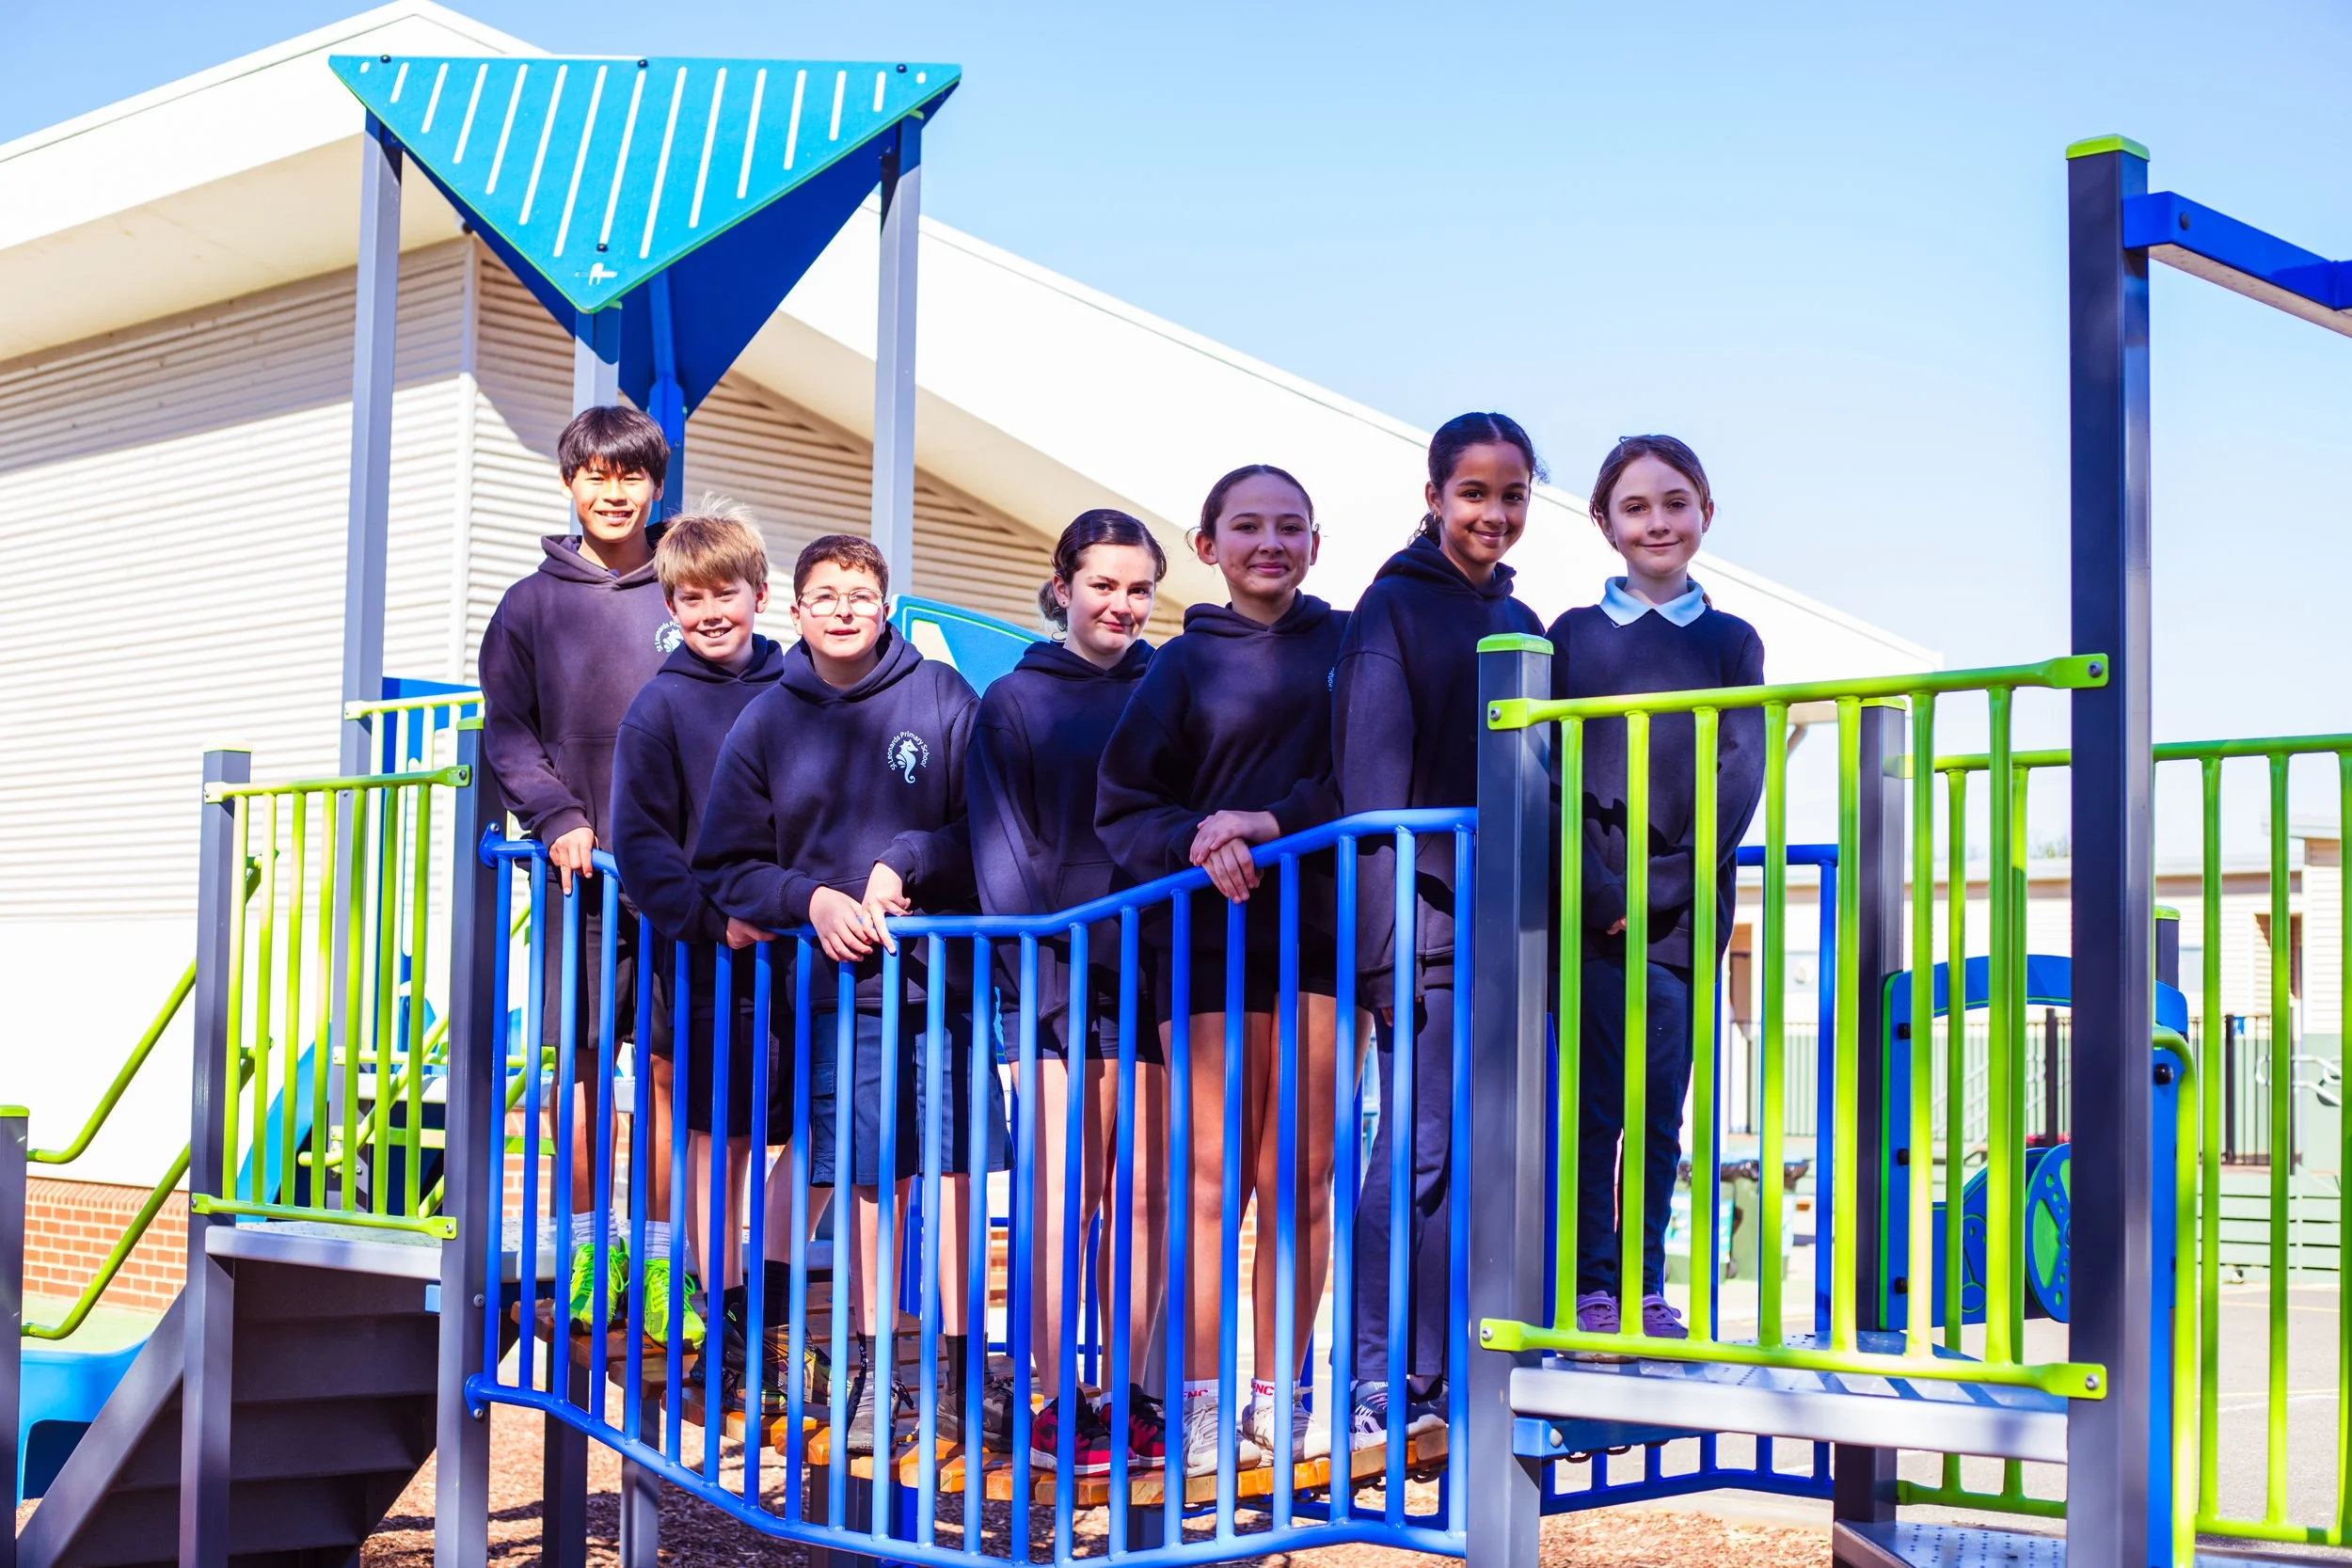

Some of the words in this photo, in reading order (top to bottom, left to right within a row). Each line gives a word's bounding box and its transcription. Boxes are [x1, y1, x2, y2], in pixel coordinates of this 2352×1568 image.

[887, 735, 901, 764] Leonards
[899, 730, 924, 745] Primary
[920, 744, 930, 768] School
